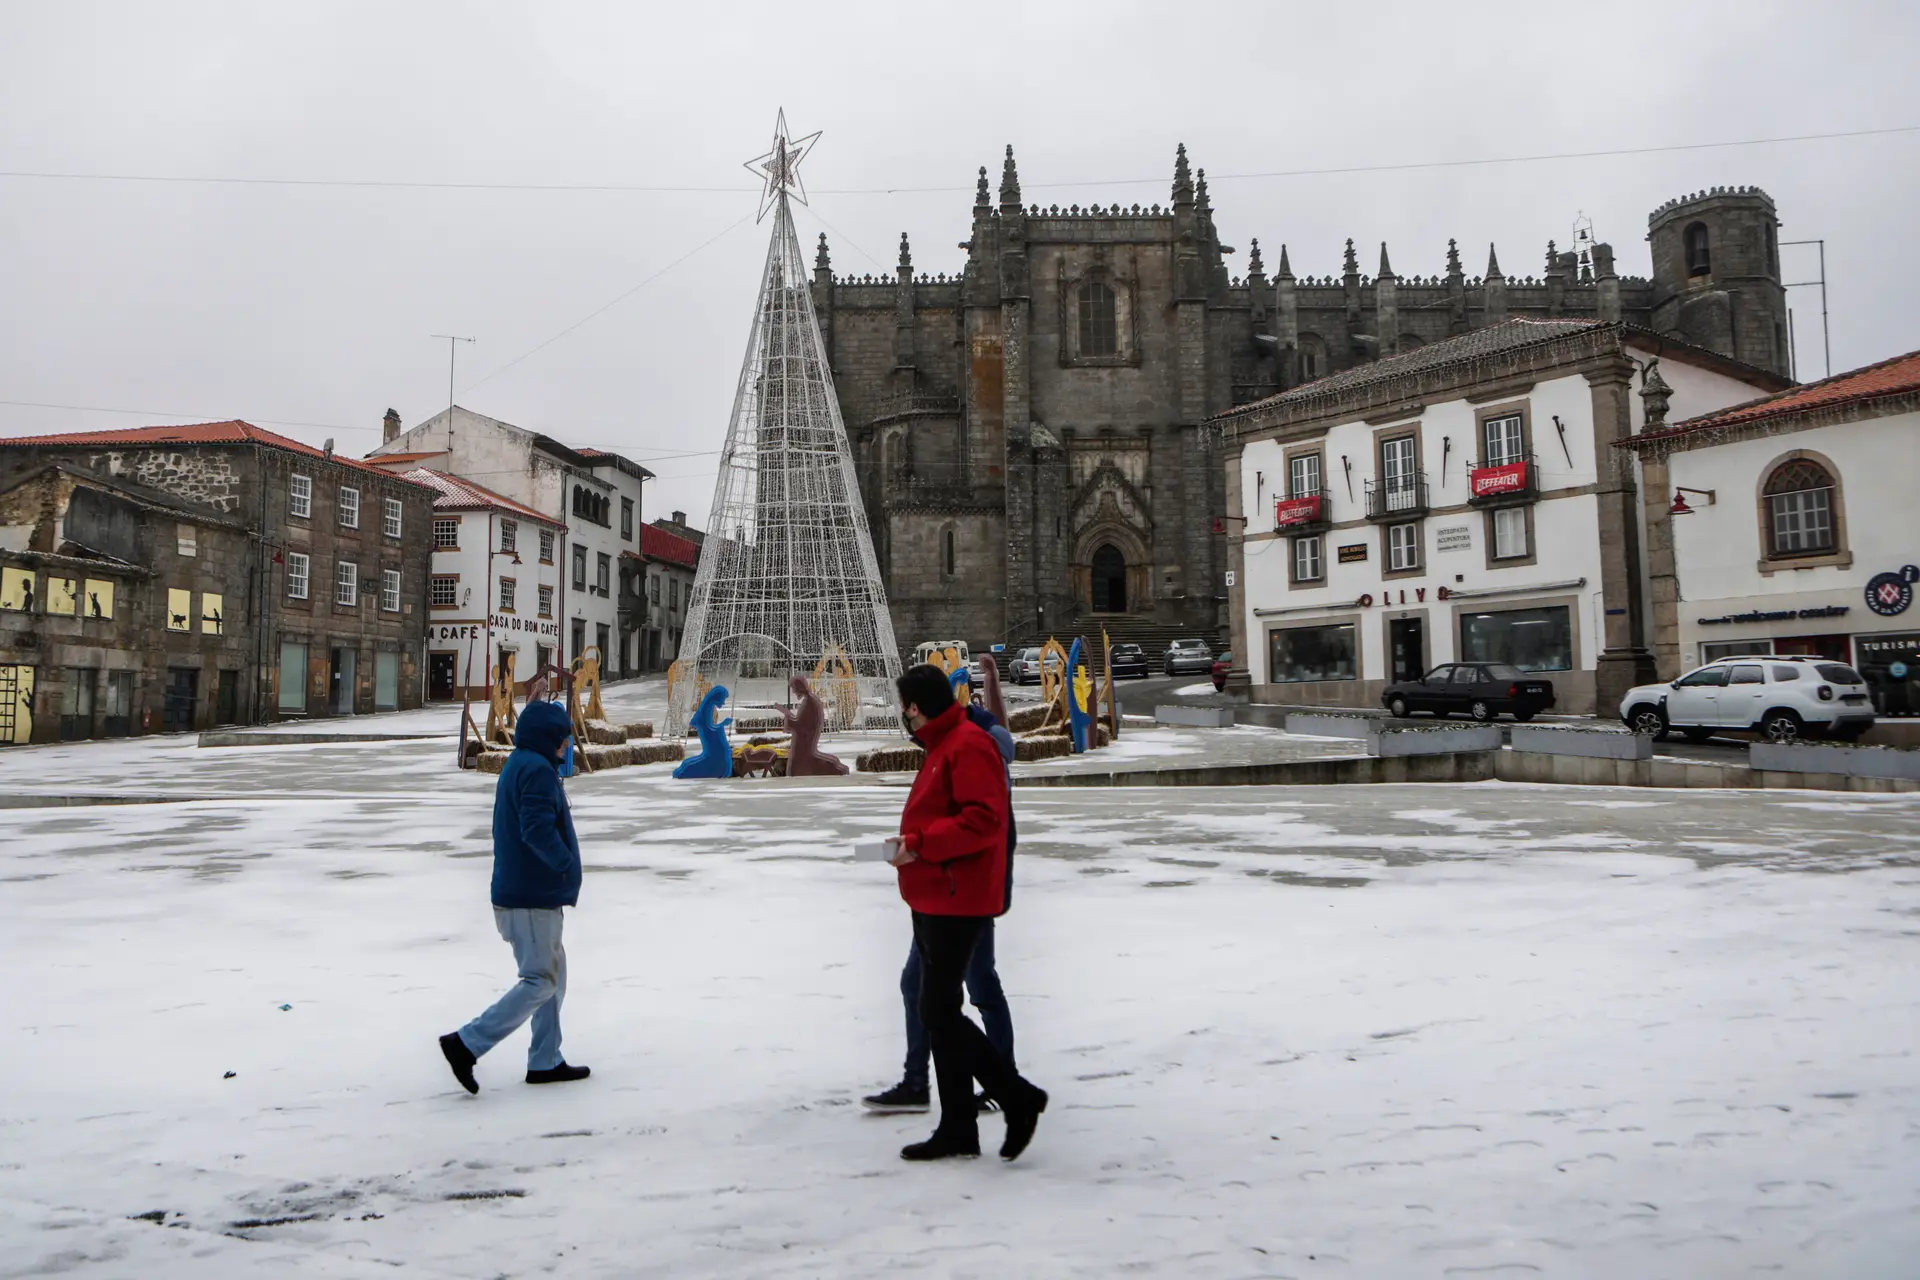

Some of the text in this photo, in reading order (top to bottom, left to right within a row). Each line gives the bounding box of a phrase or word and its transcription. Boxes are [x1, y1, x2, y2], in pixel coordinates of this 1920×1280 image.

[1476, 473, 1519, 492] BEEFEATER
[440, 625, 478, 640] CAFÉ
[489, 614, 559, 637] CASA DO BOM CAFÉ
[1863, 641, 1920, 651] TURISM
